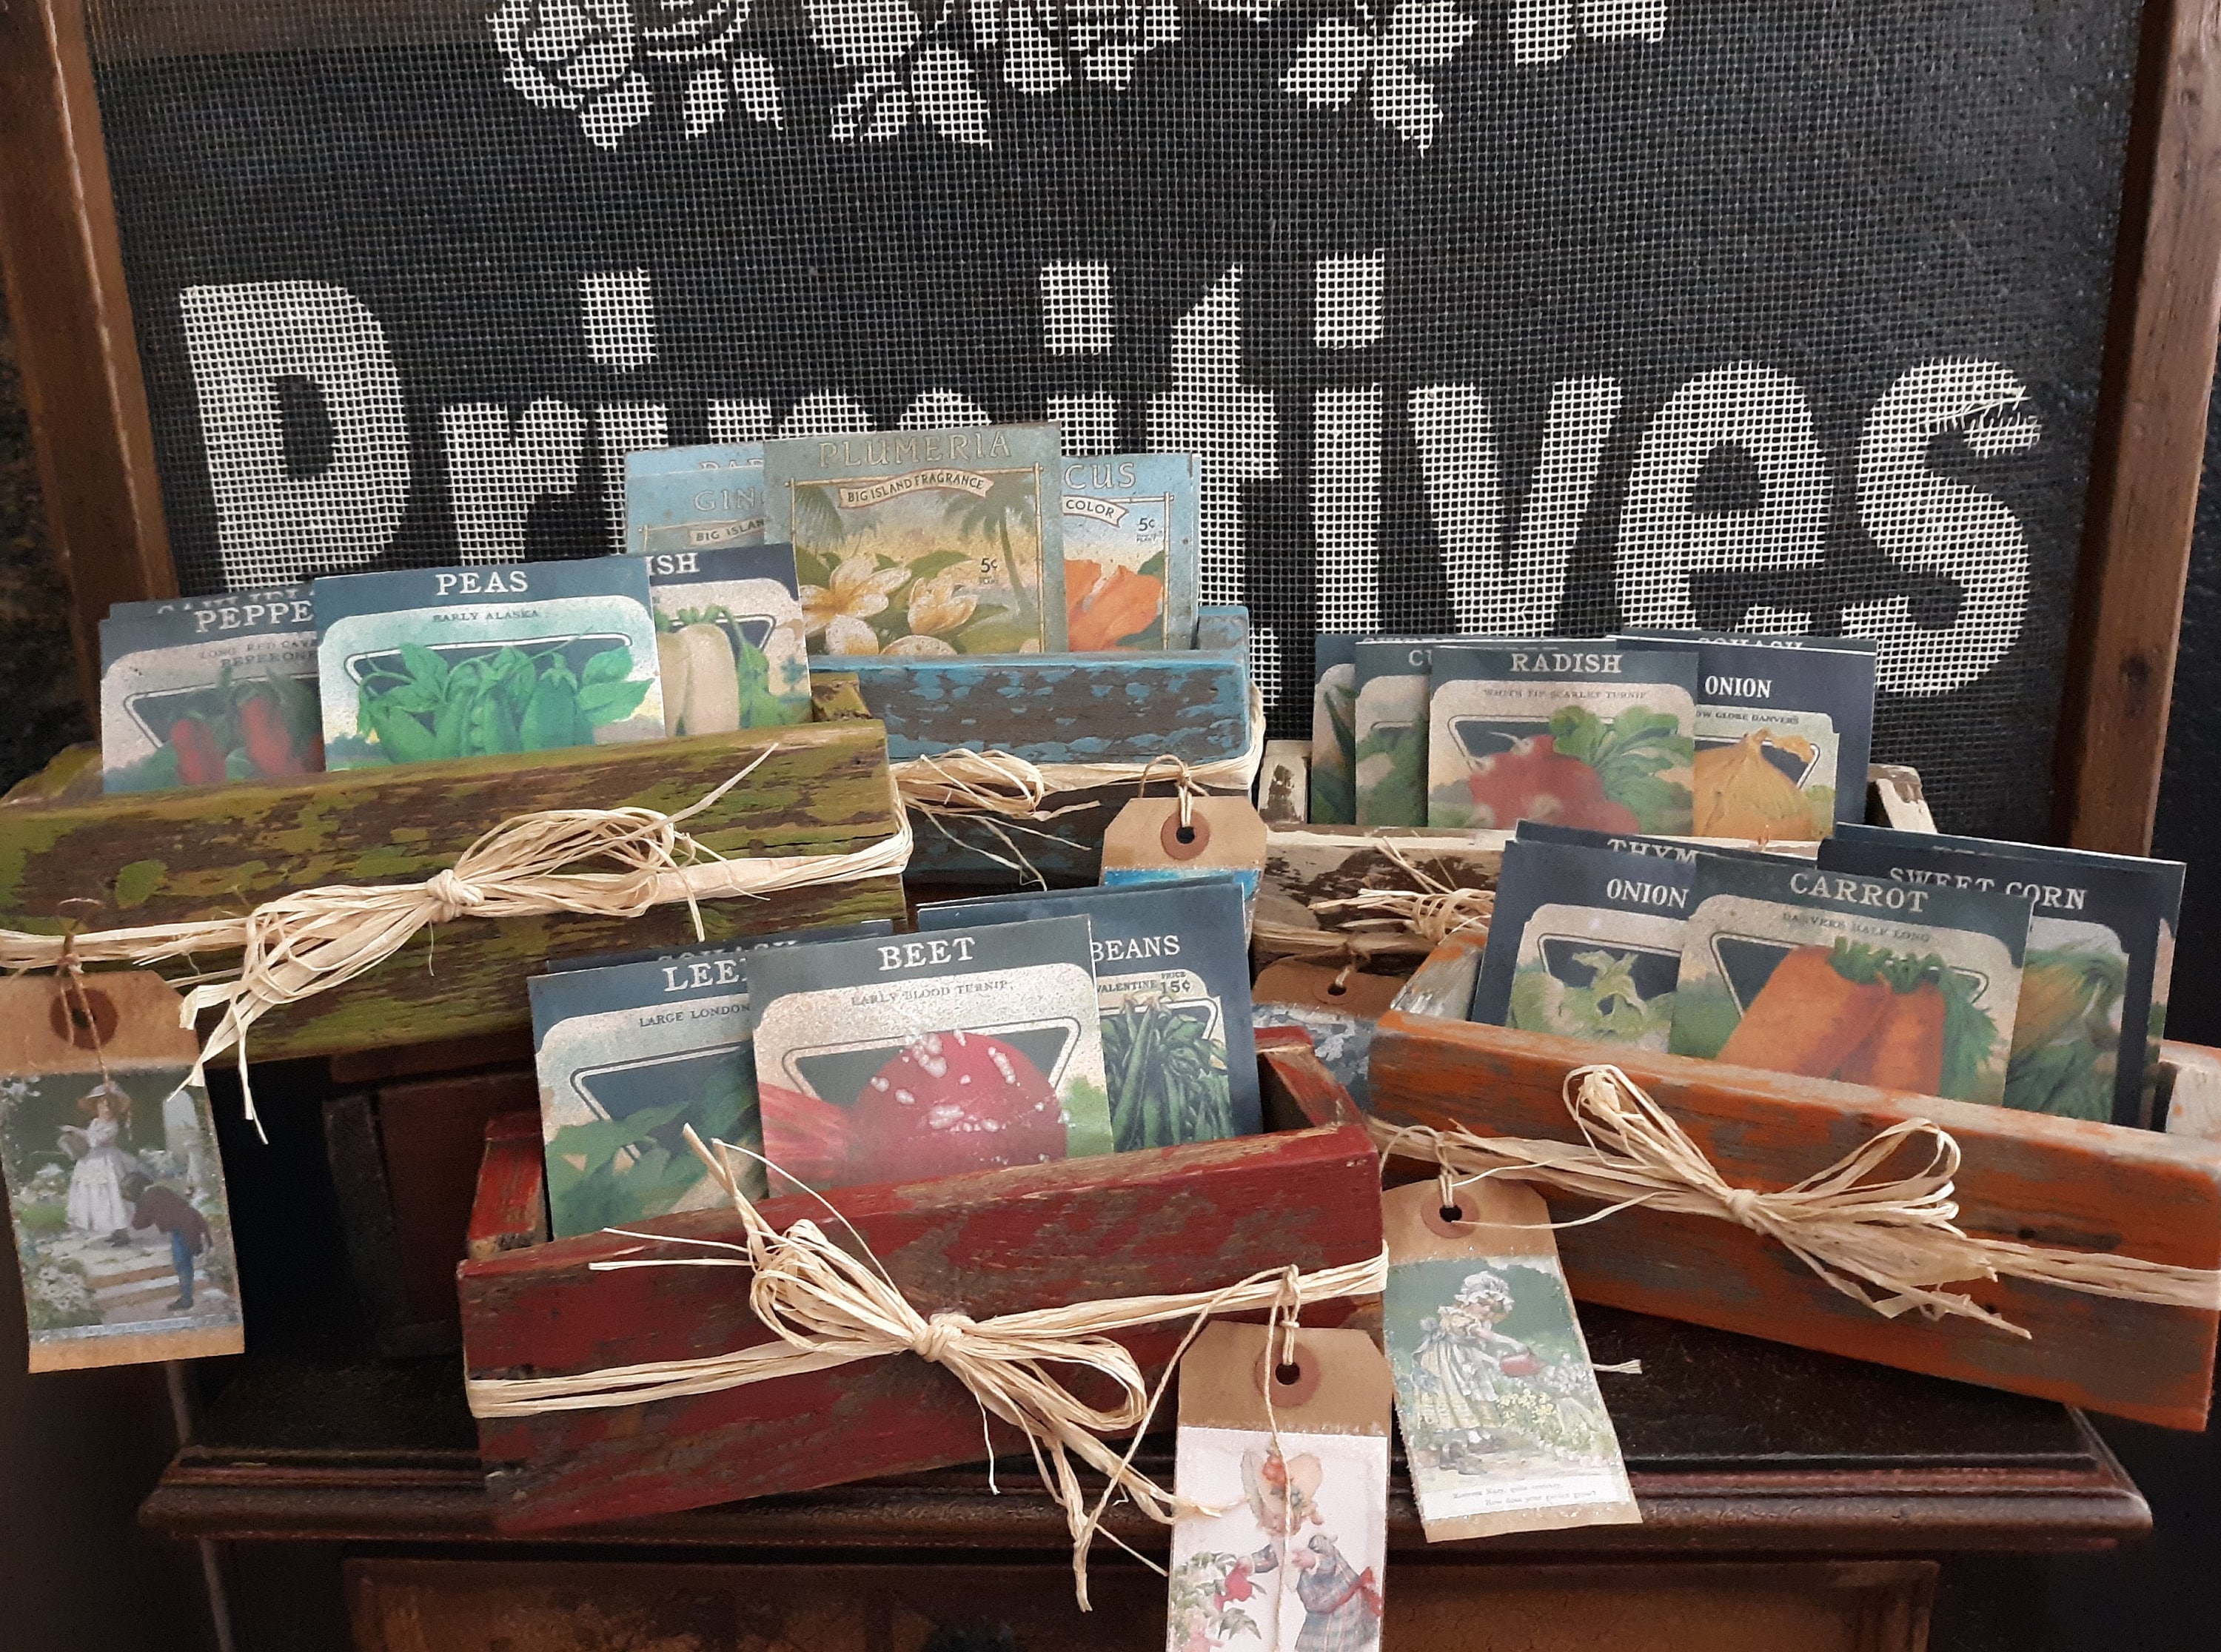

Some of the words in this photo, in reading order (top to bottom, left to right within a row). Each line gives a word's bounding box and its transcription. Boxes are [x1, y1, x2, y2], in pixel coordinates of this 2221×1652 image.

[817, 430, 1011, 468] PLUMERIA
[181, 250, 2042, 707] Pritives
[848, 486, 868, 503] BIG
[871, 478, 912, 499] ISLAND
[914, 472, 985, 489] FRAGRANCE
[694, 487, 764, 511] GIN
[1065, 499, 1115, 517] COLOR
[696, 530, 720, 542] BIG
[1138, 517, 1156, 531] 5¢
[980, 557, 999, 573] 5¢
[435, 570, 529, 596] PEAS
[193, 600, 315, 634] PEPPE
[485, 610, 539, 620] ALASKA
[1509, 652, 1624, 674] RADISH
[1704, 675, 1772, 699] ONION
[1606, 878, 1689, 909] ONION
[1789, 872, 1929, 913] CARROT
[2005, 882, 2087, 910] CORN
[877, 936, 976, 971] BEET
[1091, 935, 1181, 962] BEANS
[662, 958, 747, 992] LEE
[1160, 979, 1191, 994] 15¢
[1161, 971, 1185, 979] PRICE
[904, 986, 951, 1000] BLOOD
[639, 1011, 684, 1027] LARGE
[691, 1004, 750, 1019] LONDON
